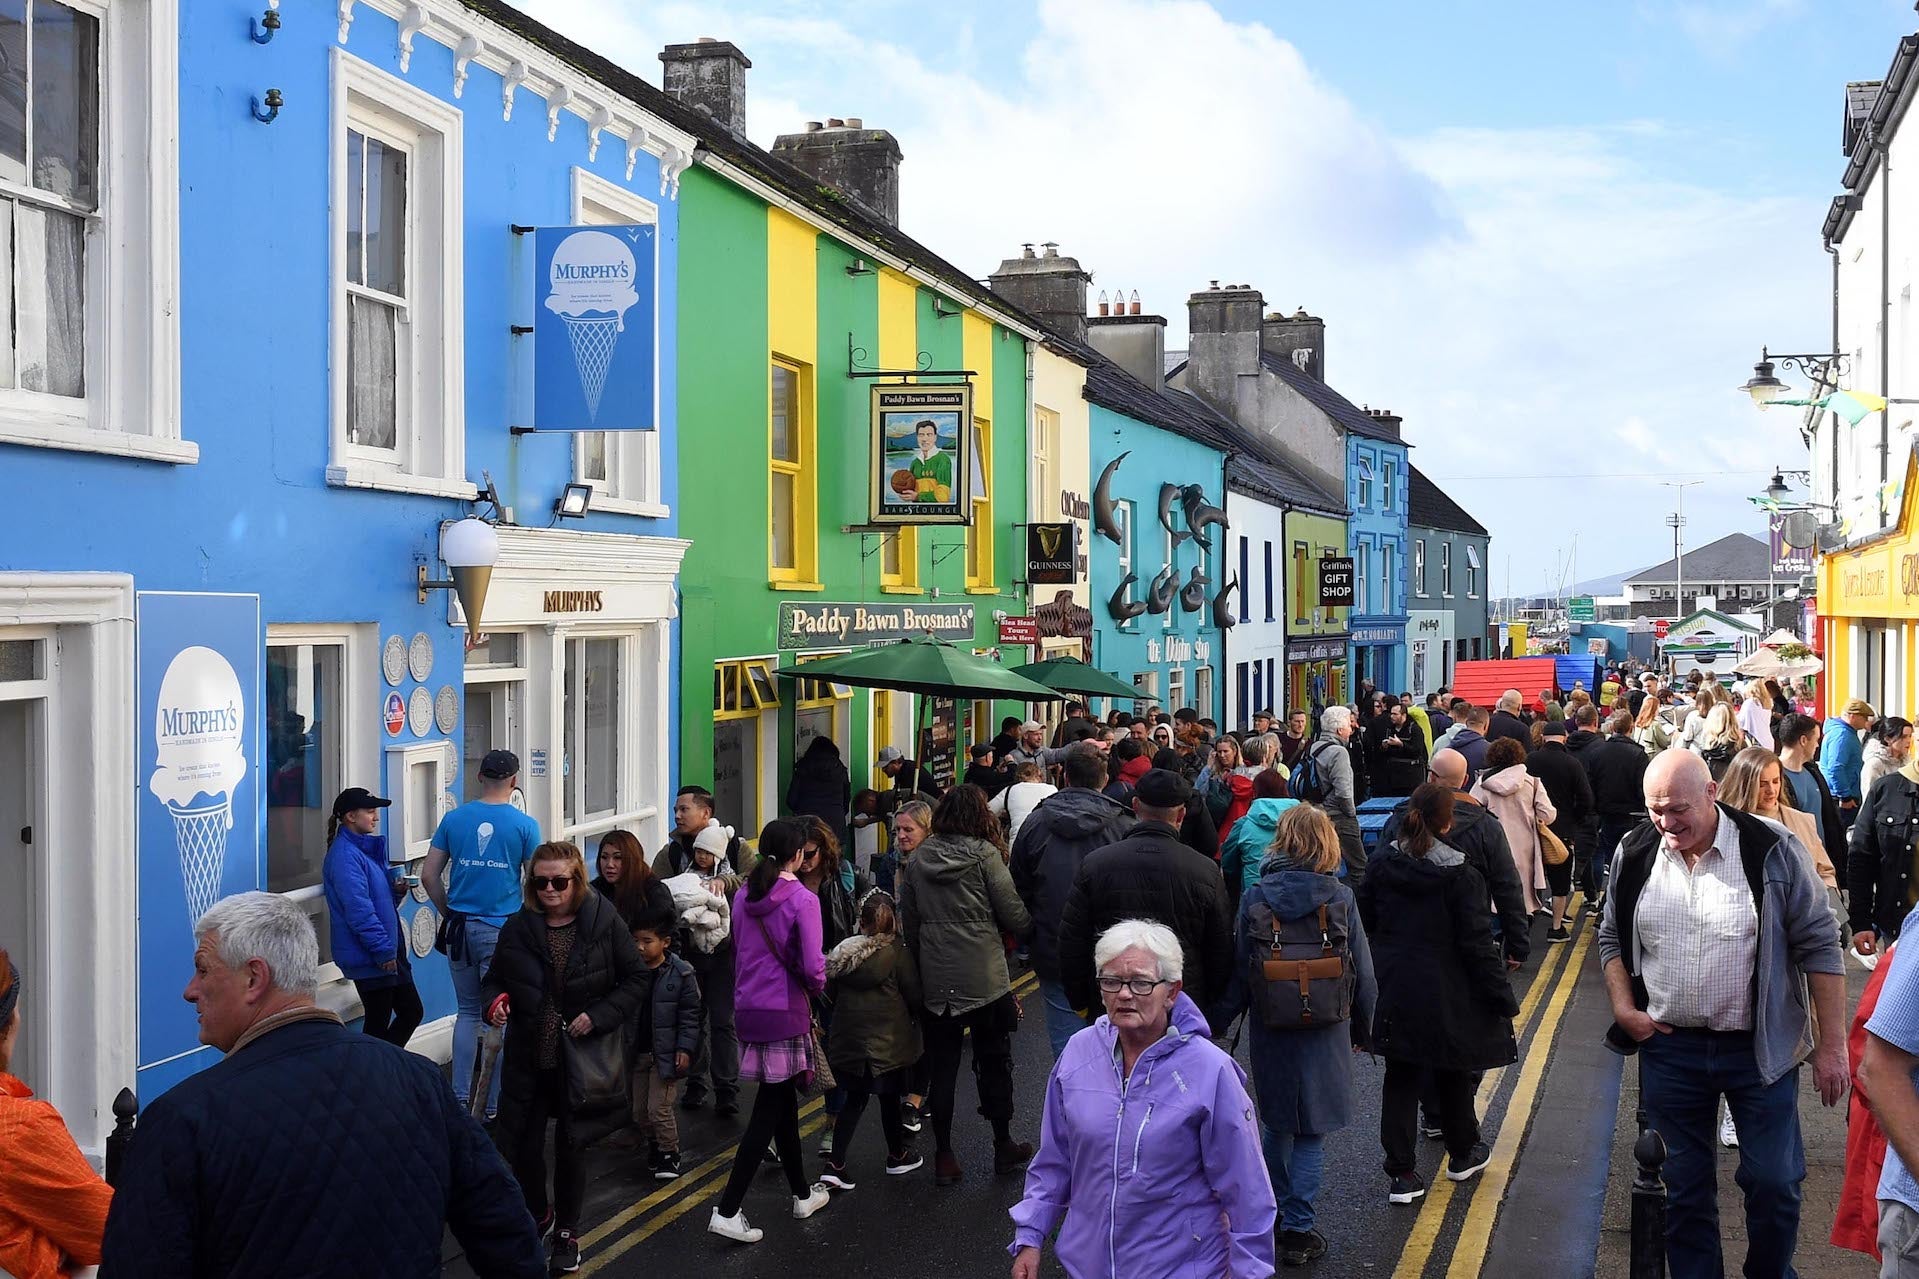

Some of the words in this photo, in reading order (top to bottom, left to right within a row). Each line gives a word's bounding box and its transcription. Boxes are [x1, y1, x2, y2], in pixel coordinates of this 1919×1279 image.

[555, 260, 628, 279] MURPHY'S
[884, 395, 906, 404] Paddy
[927, 394, 960, 403] Brosnan's
[1029, 560, 1072, 570] GUINNESS
[1322, 562, 1352, 570] Griffin's
[1324, 574, 1348, 584] GIFT
[1322, 586, 1352, 596] SHOP
[543, 590, 602, 612] MURPHYS
[792, 608, 850, 641] Paddy
[854, 608, 899, 631] Bawn
[903, 608, 968, 630] Brosnan's
[1147, 638, 1160, 662] the
[162, 700, 236, 736] MURPHY'S
[459, 858, 470, 867] óg
